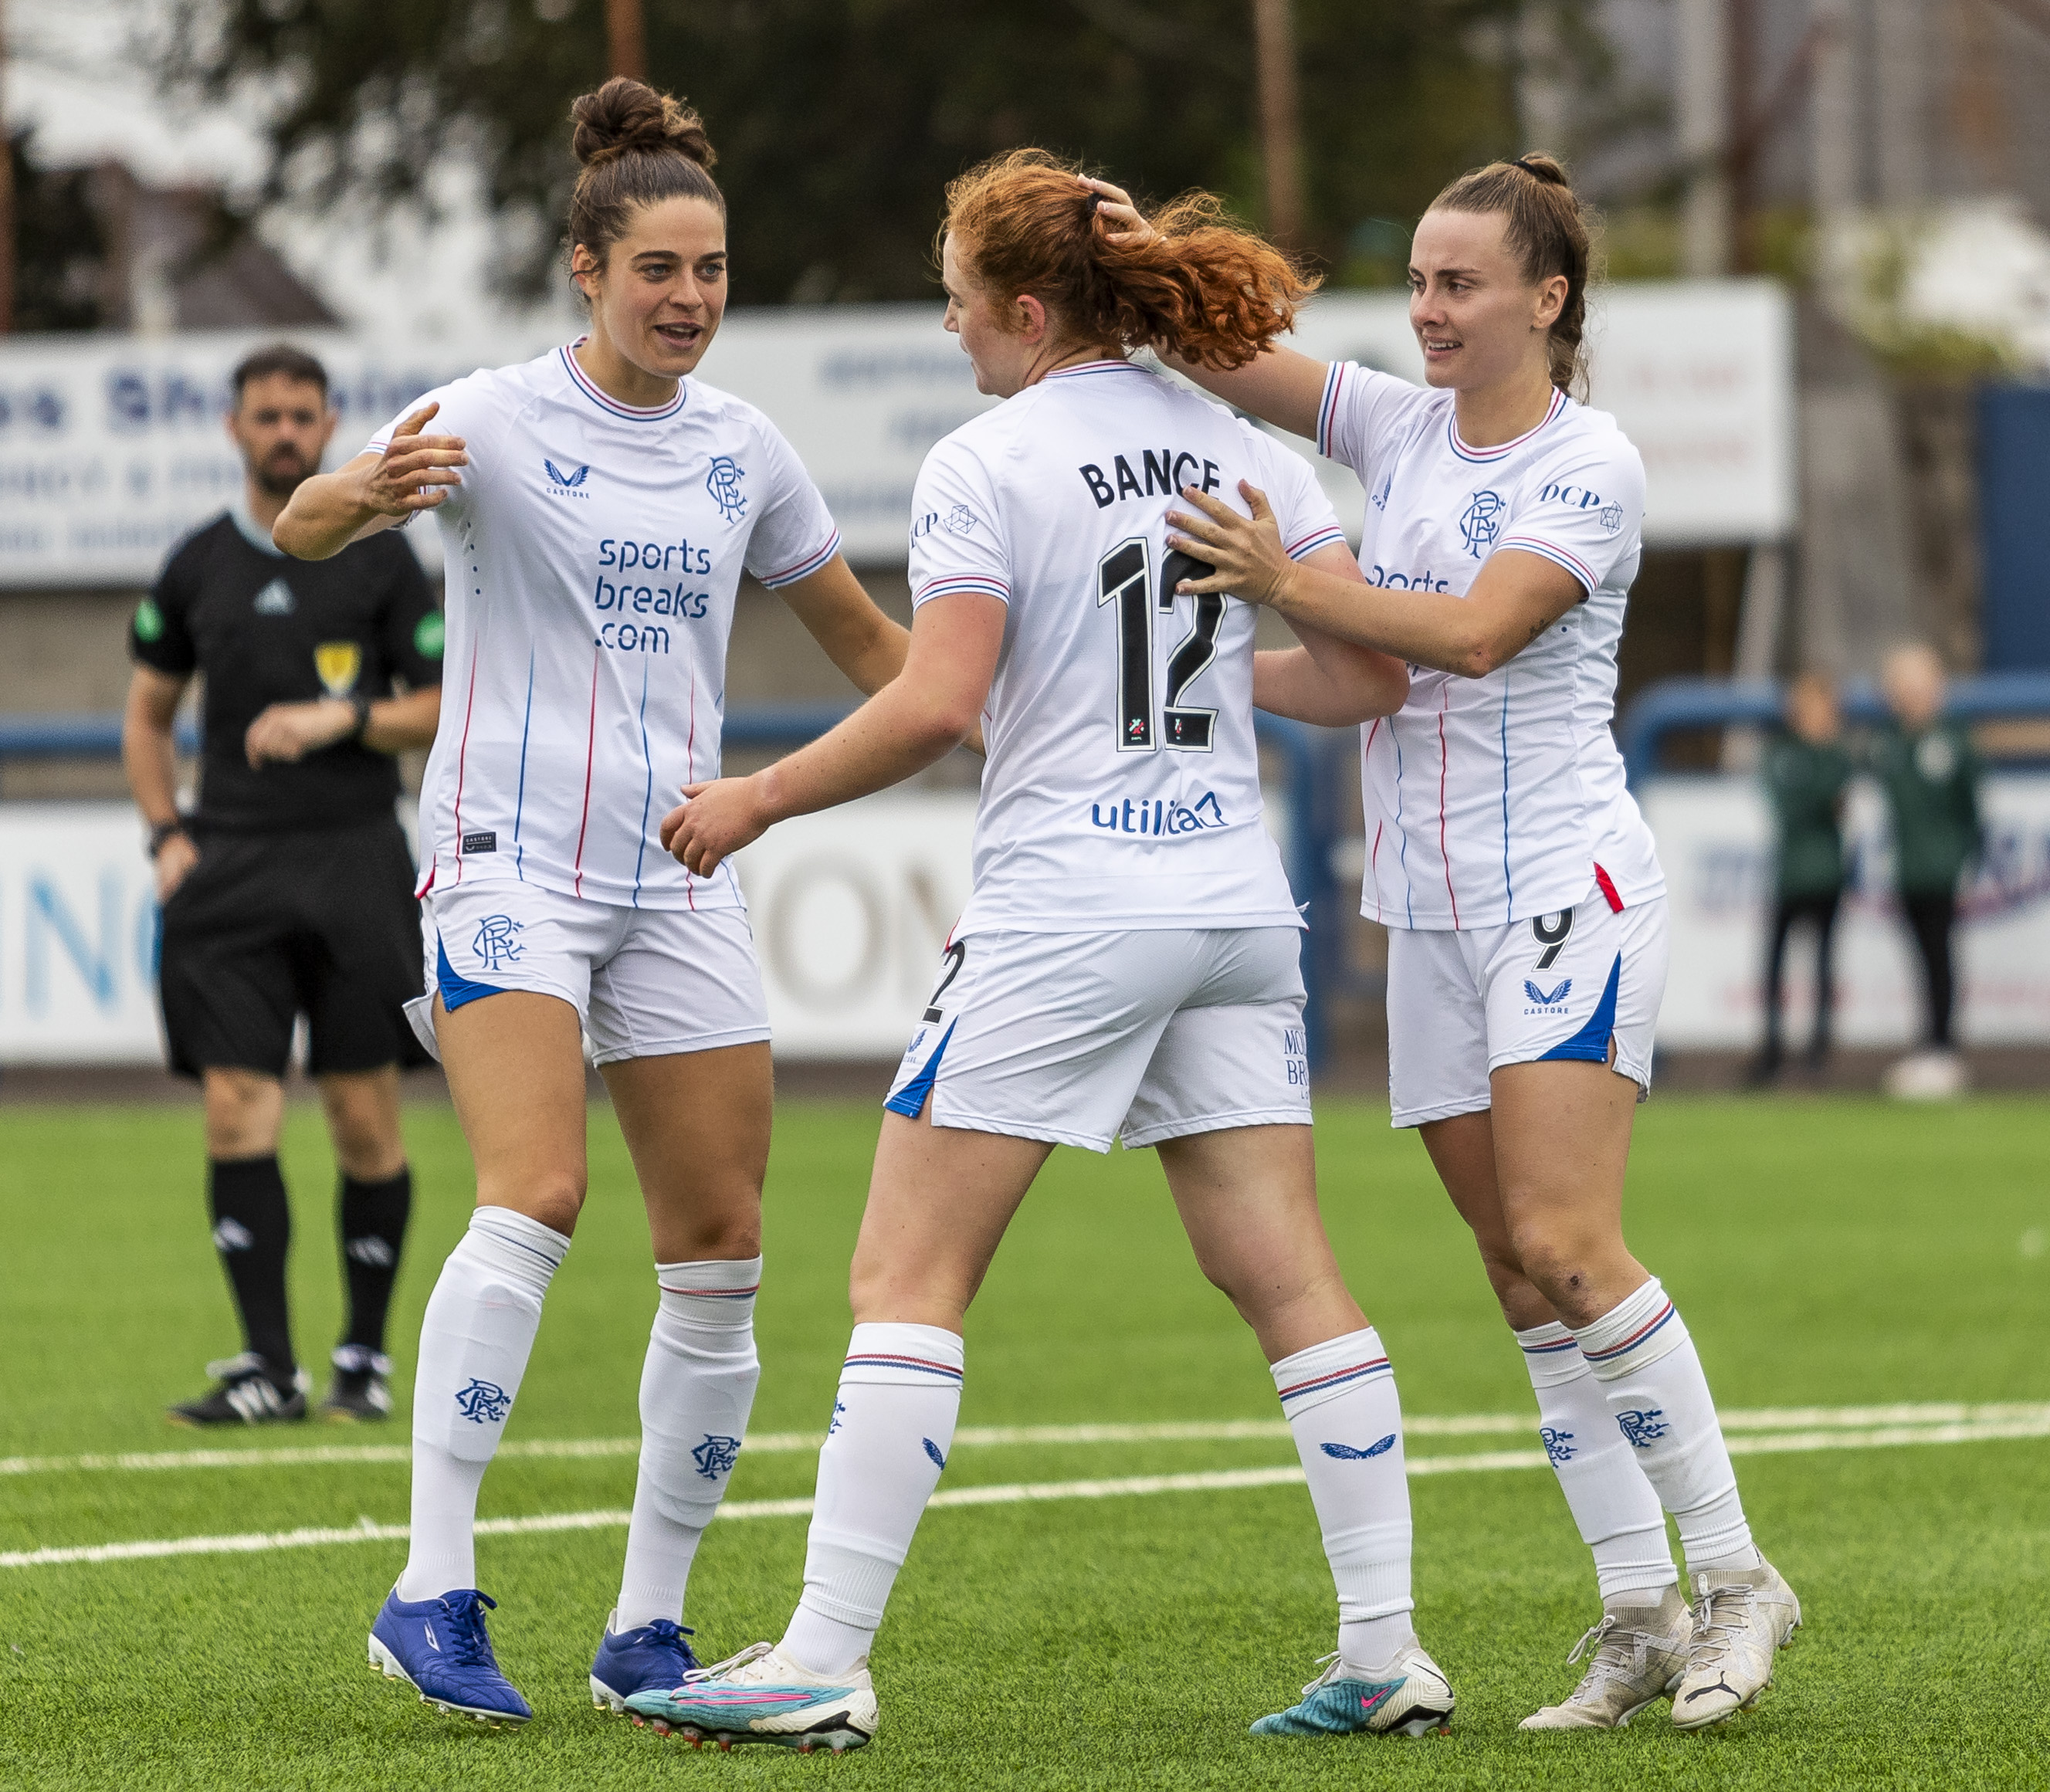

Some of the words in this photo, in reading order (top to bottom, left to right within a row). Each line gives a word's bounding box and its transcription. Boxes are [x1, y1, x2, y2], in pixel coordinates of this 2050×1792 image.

[547, 487, 589, 499] CASTORE
[1079, 449, 1220, 509] BANCE
[1540, 484, 1600, 510] DCP
[598, 538, 711, 574] sports
[595, 575, 710, 618] breaks
[595, 622, 669, 654] .com
[1098, 537, 1227, 753] 12
[1530, 906, 1576, 972] 9
[1523, 1007, 1569, 1015] CASTORE
